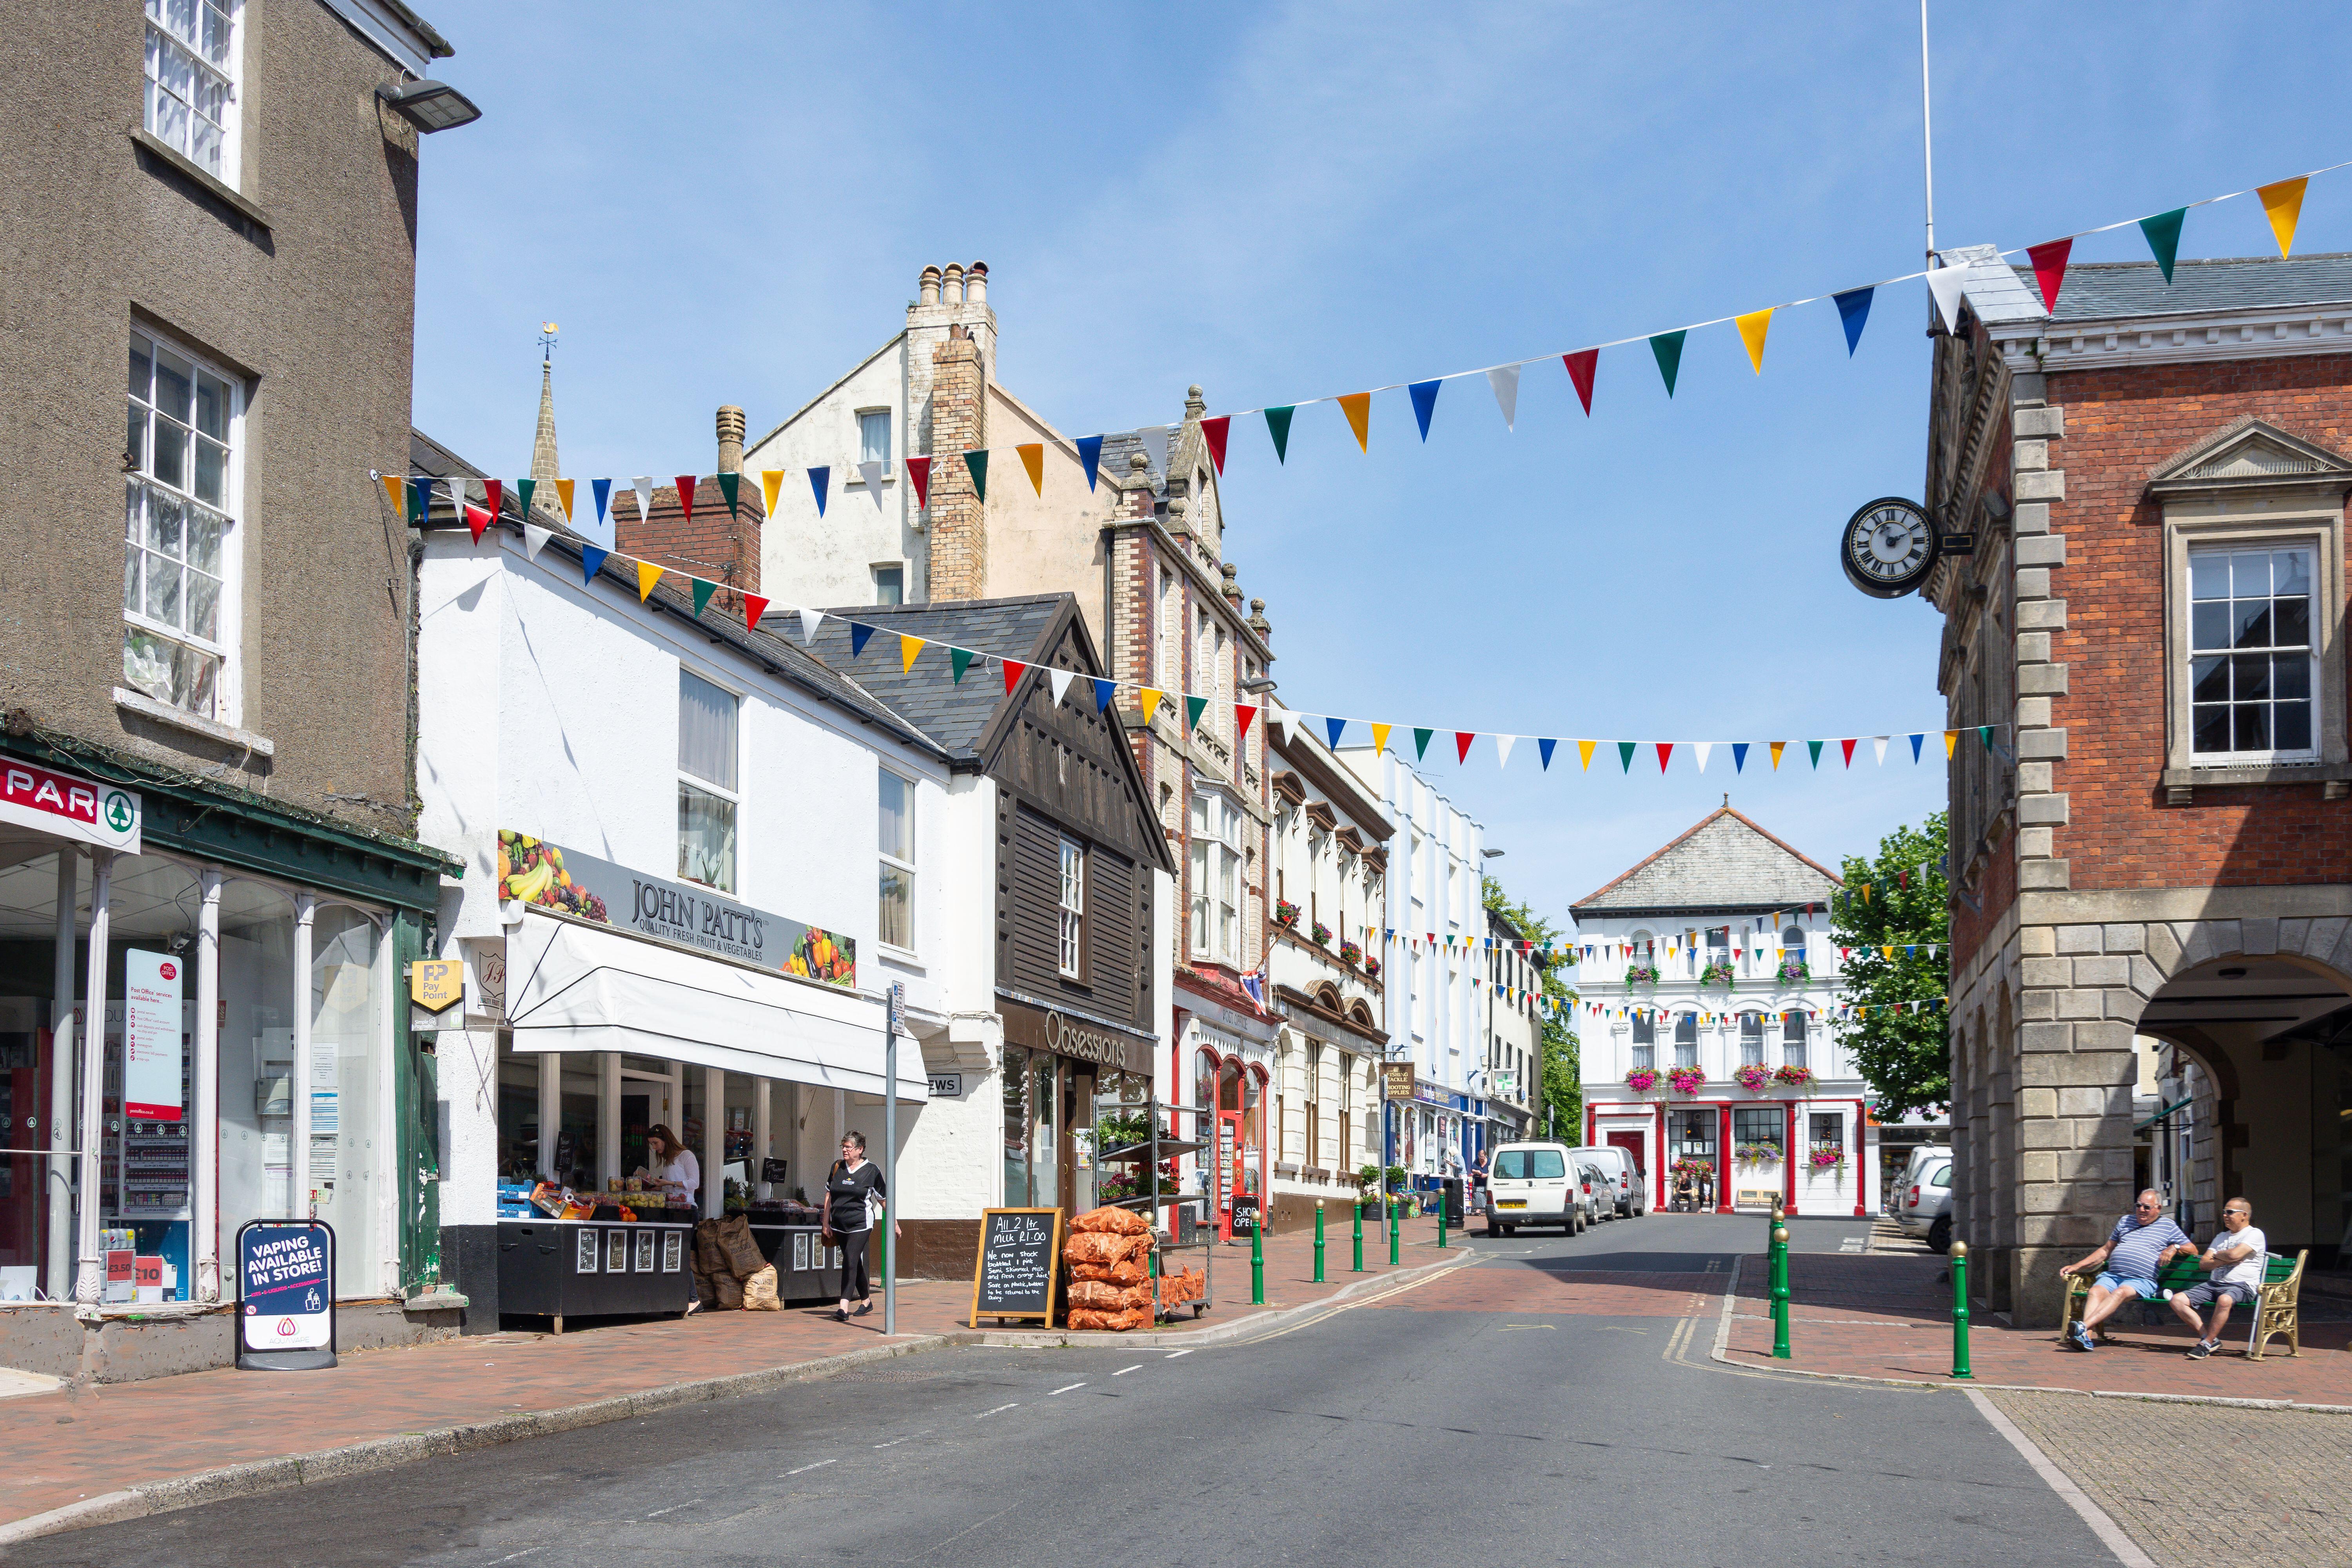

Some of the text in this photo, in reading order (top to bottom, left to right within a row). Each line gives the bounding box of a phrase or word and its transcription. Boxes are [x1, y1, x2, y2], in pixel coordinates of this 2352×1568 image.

[7, 769, 94, 817] PAR
[632, 879, 695, 930] JOHN
[701, 900, 763, 949] PATT'S
[640, 918, 762, 961] QUALITY FRESH FRUIT & VEGETABLES
[423, 982, 439, 992] Pay
[423, 991, 447, 999] Point
[1223, 1009, 1233, 1024] POST
[1045, 1009, 1125, 1067] Obsessions
[928, 1080, 955, 1090] EWS
[996, 1216, 1009, 1231] All
[1014, 1217, 1021, 1229] 2
[1019, 1231, 1046, 1242] £1.00
[252, 1236, 309, 1258] VAPING
[987, 1249, 998, 1260] We
[248, 1247, 323, 1273] AVAILABLE
[108, 1263, 131, 1273] £3.50
[136, 1268, 160, 1280] £10
[252, 1259, 322, 1286] IN STORE!
[263, 1285, 288, 1294] E-LIQUIDS
[290, 1278, 321, 1289] ACCESSORIES
